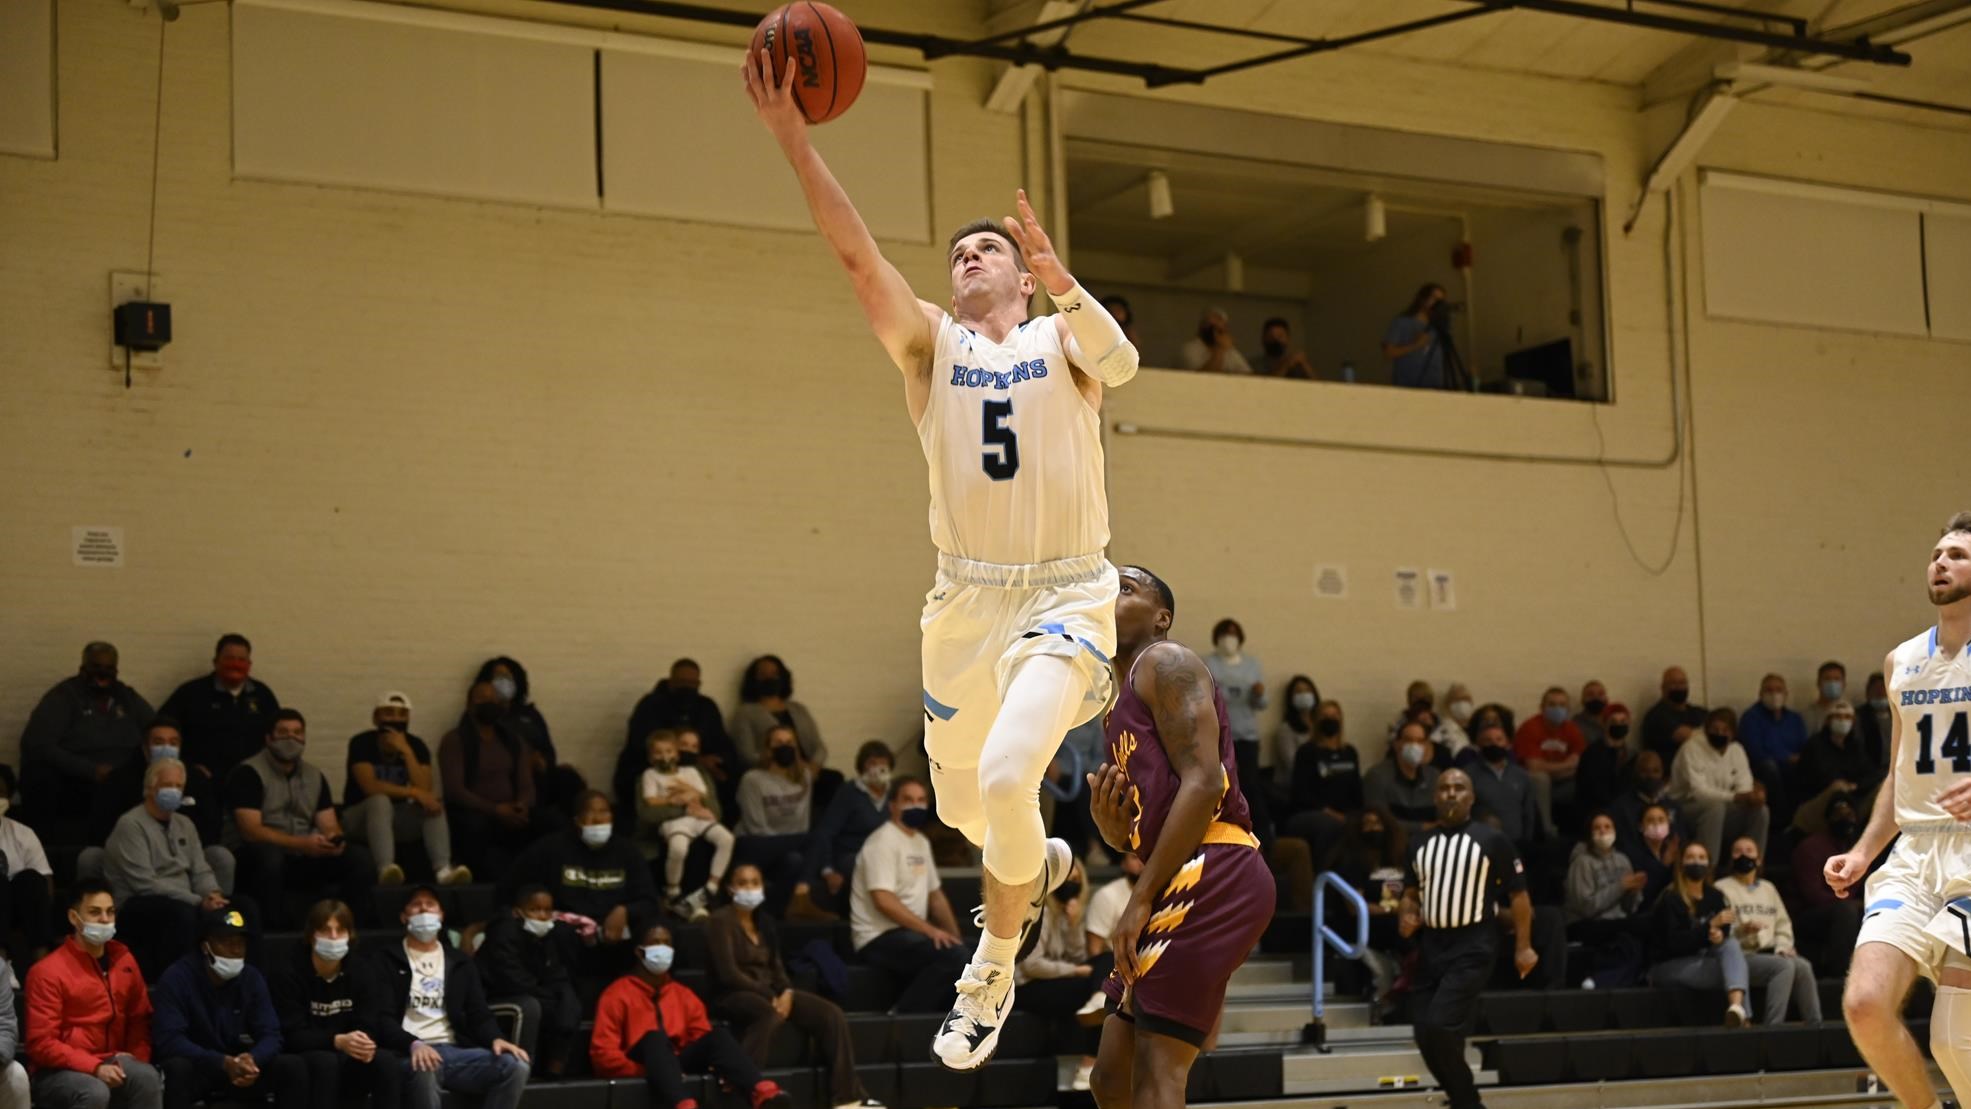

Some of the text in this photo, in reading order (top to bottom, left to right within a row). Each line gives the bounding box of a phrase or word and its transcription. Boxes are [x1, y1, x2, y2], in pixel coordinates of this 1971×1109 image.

[794, 27, 820, 88] NCAA
[981, 397, 1019, 481] 5
[1915, 711, 1971, 774] 14
